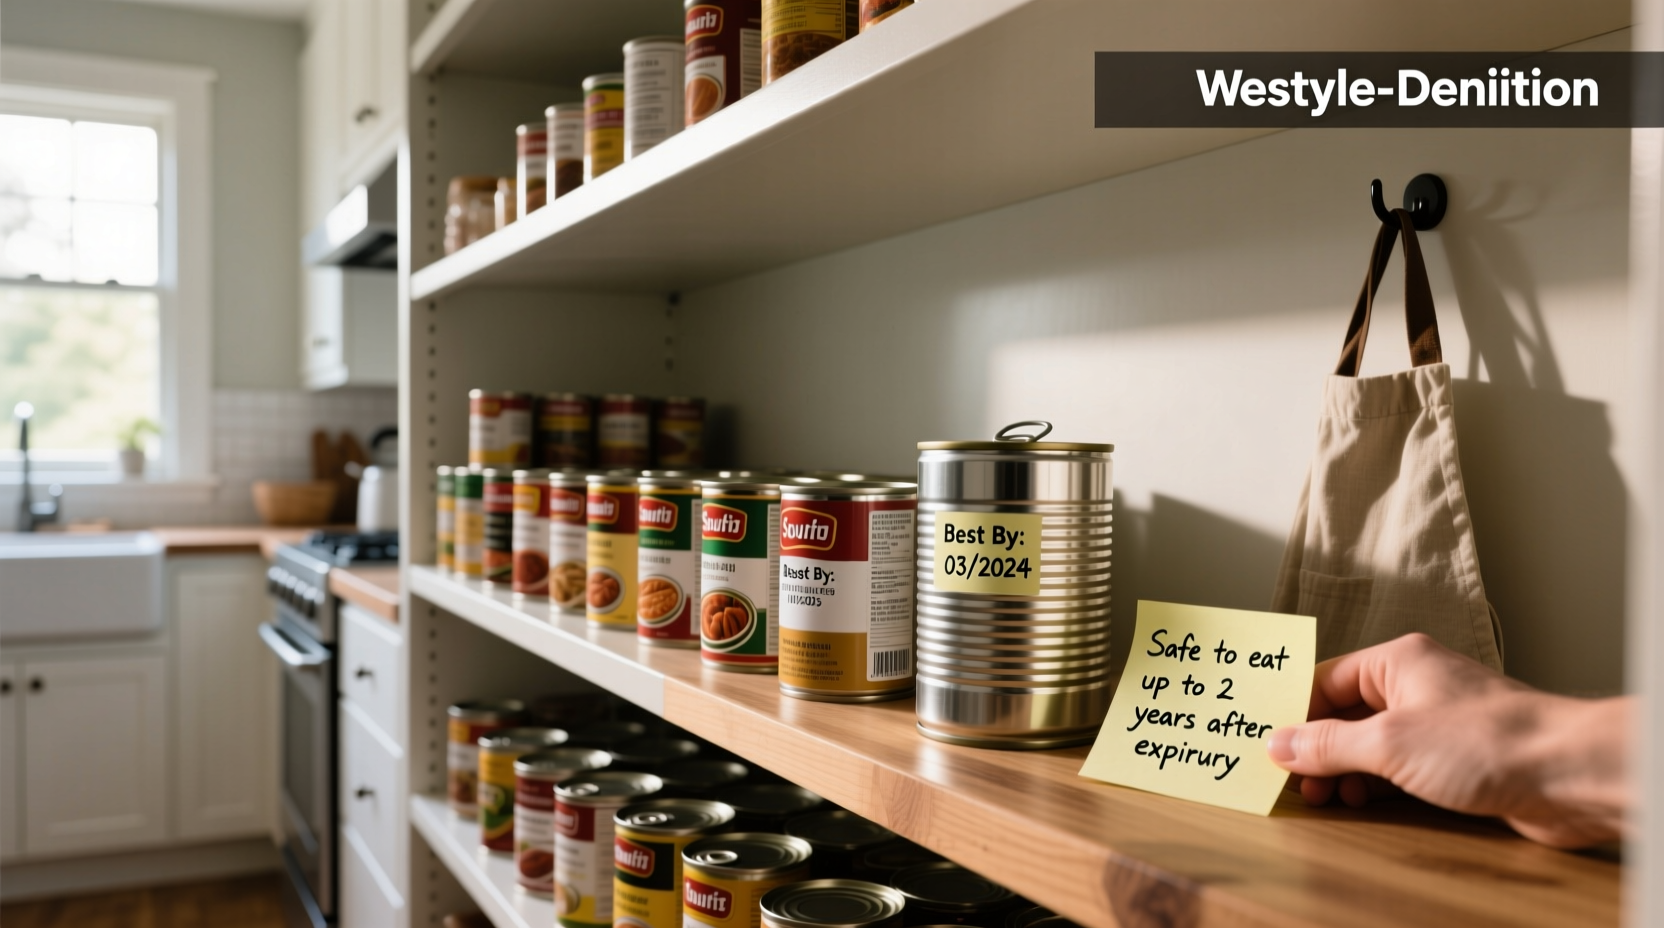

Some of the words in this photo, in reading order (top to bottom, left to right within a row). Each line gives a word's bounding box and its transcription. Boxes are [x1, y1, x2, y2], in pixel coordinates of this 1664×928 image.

[944, 523, 985, 545] Best
[992, 525, 1025, 550] By:
[813, 567, 835, 586] By:
[944, 553, 1033, 580] 03/2024
[1146, 629, 1201, 662] Safe
[1213, 639, 1238, 665] to
[1248, 645, 1290, 671] eat
[1141, 674, 1170, 700] up
[1181, 673, 1205, 696] to
[1216, 677, 1234, 700] 2
[1126, 704, 1196, 732] years
[1206, 711, 1273, 739] after
[1134, 739, 1241, 781] expirury
